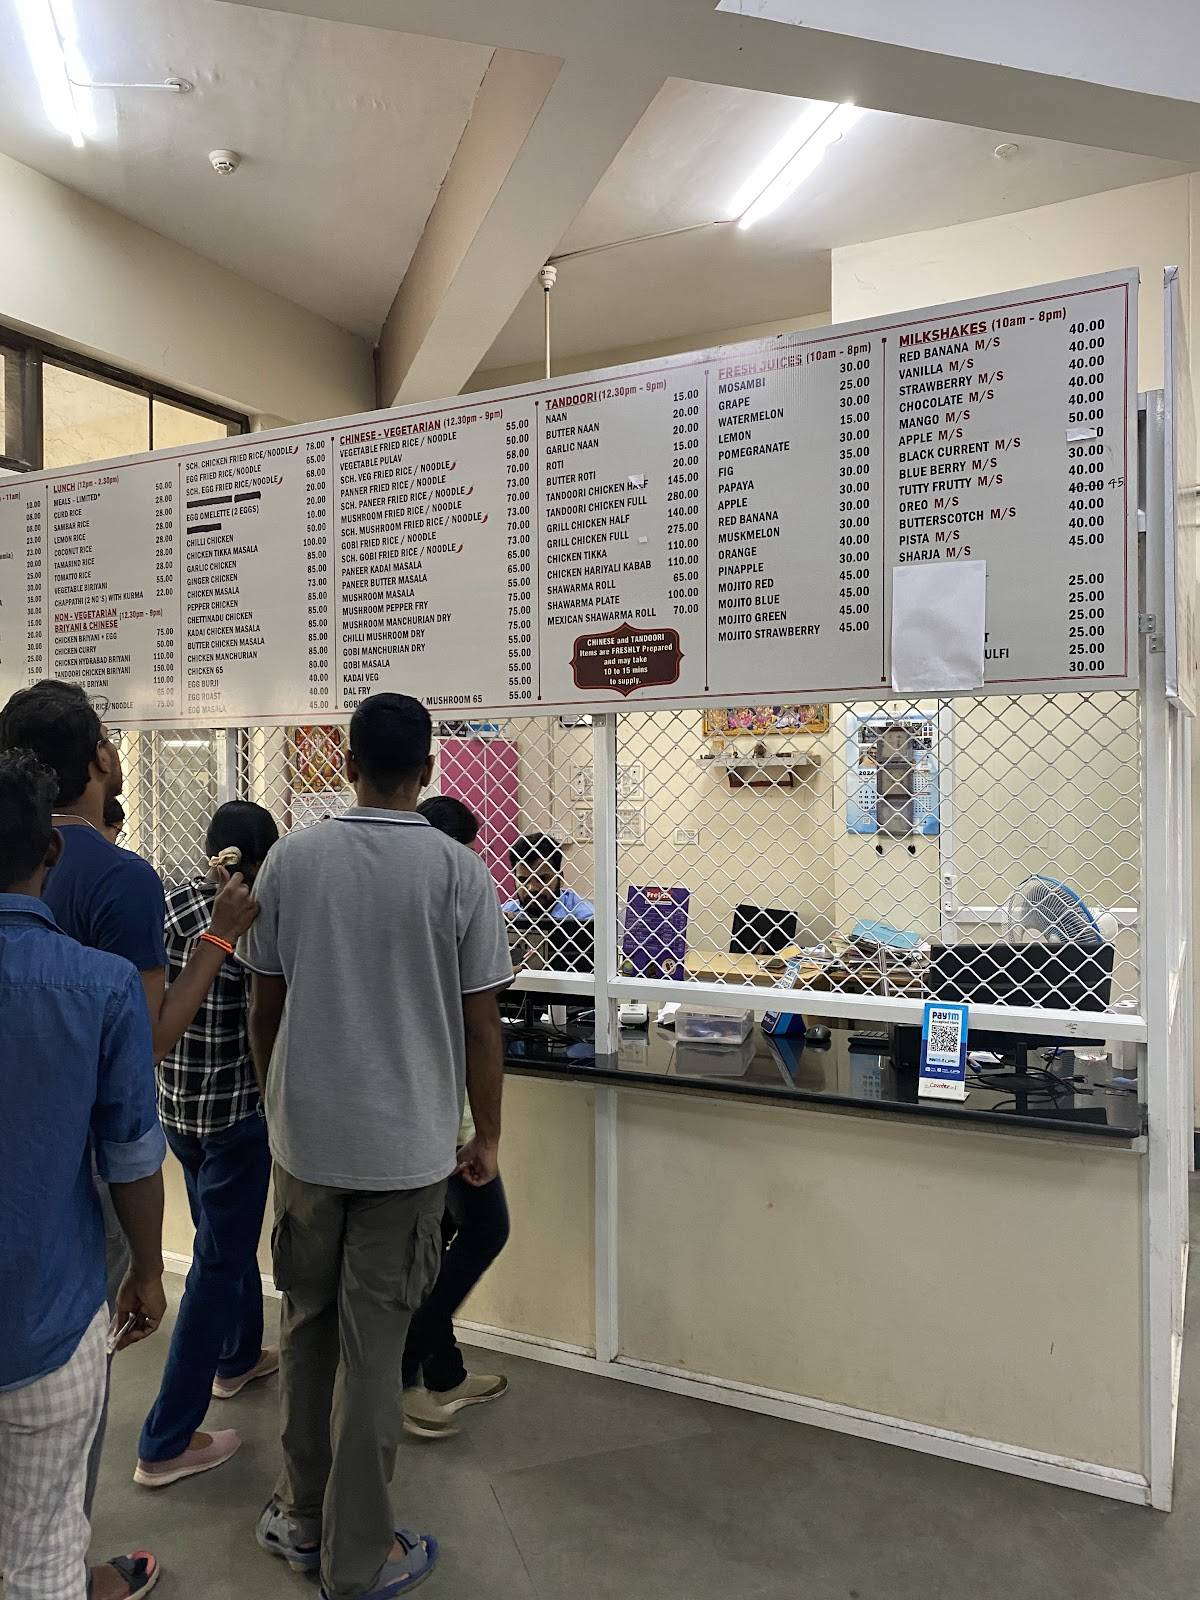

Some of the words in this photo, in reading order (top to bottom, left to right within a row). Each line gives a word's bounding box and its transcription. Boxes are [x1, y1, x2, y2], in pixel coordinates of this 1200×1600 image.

[899, 320, 987, 347] MILKSHAKES
[991, 316, 1026, 332] (10am
[1038, 307, 1066, 323] 8pm)
[900, 351, 920, 363] RED
[924, 342, 969, 359] BANANA
[975, 337, 1000, 351] M/S
[1069, 319, 1105, 334] 40.00
[718, 363, 757, 380] FRESH
[759, 354, 802, 374] JUICES
[806, 350, 836, 364] (10am
[847, 342, 871, 355] 8pm)
[899, 363, 943, 380] VANILLA
[949, 358, 974, 373] M/S
[1069, 337, 1104, 352] 40.00
[719, 378, 765, 395] MOSAMBI
[840, 359, 870, 373] 30.00
[545, 392, 597, 410] TANDOORI
[598, 385, 637, 402] (12.30pm
[646, 379, 666, 392] 9pm)
[546, 412, 567, 424] NAAN
[674, 389, 699, 402] 15.00
[719, 397, 750, 411] GRAPE
[840, 377, 870, 391] 25.00
[900, 394, 963, 413] CHOCOLATE
[969, 389, 994, 404] M/S
[1069, 373, 1104, 388] 40.00
[546, 427, 575, 440] BUTTER
[578, 422, 599, 434] NAAN
[673, 406, 699, 419] 20.00
[718, 408, 783, 428] WATERMELON
[840, 394, 870, 408] 30.00
[900, 414, 939, 430] MANGO
[946, 410, 970, 424] M/S
[1068, 391, 1104, 405] 40.00
[340, 430, 376, 446] CHINESE
[383, 420, 441, 440] VEGETARIAN
[443, 414, 477, 428] (12.30pm
[485, 409, 503, 420] 9pm)
[719, 430, 751, 444] LEMON
[841, 412, 870, 425] 15.00
[899, 432, 933, 446] APPLE
[939, 428, 963, 441] M/S
[1068, 409, 1104, 423] 50.00
[546, 460, 564, 471] ROTI
[674, 438, 699, 451] 15.00
[719, 441, 790, 461] POMEGRANATE
[840, 429, 870, 443] 30.00
[719, 466, 734, 477] FIG
[840, 447, 870, 460] 35.00
[341, 486, 368, 498] PANNER
[370, 483, 390, 494] FRIED
[392, 480, 409, 491] RICE
[410, 480, 414, 490] /
[417, 475, 446, 487] NOODLE
[507, 462, 529, 474] 70.00
[899, 483, 930, 496] TUTTY
[933, 477, 972, 492] FRUTTY
[978, 474, 1003, 488] M/S
[1069, 462, 1104, 476] 40.00
[186, 513, 198, 522] EGG
[200, 509, 230, 520] OMELETTE
[232, 508, 238, 517] (2
[240, 505, 259, 515] EGGS)
[306, 495, 326, 505] 20.00
[546, 504, 586, 518] TANDOORI
[588, 499, 625, 512] CHICKEN
[627, 496, 647, 507] FULL
[668, 489, 699, 501] 280.00
[719, 516, 737, 527] RED
[740, 511, 779, 524] BANANA
[840, 499, 869, 512] 30.00
[899, 500, 928, 513] OREO
[934, 496, 959, 510] M/S
[900, 510, 984, 529] BUTTERSCOTCH
[991, 507, 1016, 521] M/S
[1069, 497, 1104, 511] 40.00
[718, 527, 780, 544] MUSKMELON
[840, 516, 869, 529] 30.00
[547, 552, 582, 564] CHICKEN
[584, 549, 607, 560] TIKKA
[668, 538, 699, 551] 110.00
[899, 549, 941, 565] SHARJA
[946, 546, 971, 559] M/S
[1069, 533, 1104, 546] 45.00
[342, 579, 369, 590] PANEER
[371, 577, 396, 587] BUTTER
[398, 574, 428, 584] MASALA
[508, 563, 530, 574] 65.00
[342, 605, 384, 616] MUSHROOM
[386, 602, 413, 612] PEPPER
[415, 601, 429, 610] FRY
[508, 591, 531, 602] 75.00
[548, 598, 594, 610] SHAWARMA
[596, 595, 620, 606] PLATE
[668, 587, 699, 599] 100.00
[548, 614, 583, 626] MEXICAN
[585, 610, 633, 623] SHAWARMA
[636, 608, 656, 618] ROLL
[674, 604, 699, 615] 70.00
[188, 641, 210, 650] BUTTER
[211, 639, 238, 648] CHICKEN
[240, 637, 265, 646] MASALA
[308, 632, 328, 642] 85.00
[587, 636, 615, 646] CHINESE
[631, 633, 665, 643] TANDOORI
[718, 630, 752, 642] MOJITO
[754, 625, 820, 639] STRAWBERRY
[839, 621, 869, 632] 45.00
[55, 648, 77, 656] CHICKEN
[79, 646, 96, 654] CURRY
[157, 640, 174, 648] 50.00
[343, 660, 360, 669] GOBI
[362, 659, 390, 668] MASALA
[509, 648, 531, 658] 55.00
[604, 658, 617, 666] and
[618, 658, 631, 666] may
[632, 655, 647, 663] take
[612, 645, 640, 654] FRESHLY
[642, 643, 673, 653] Prepared
[1069, 643, 1105, 655] 25.00
[188, 667, 214, 676] CHICKEN
[216, 666, 223, 674] 65
[309, 660, 328, 669] 80.00
[610, 677, 617, 686] to
[618, 676, 642, 687] supply.
